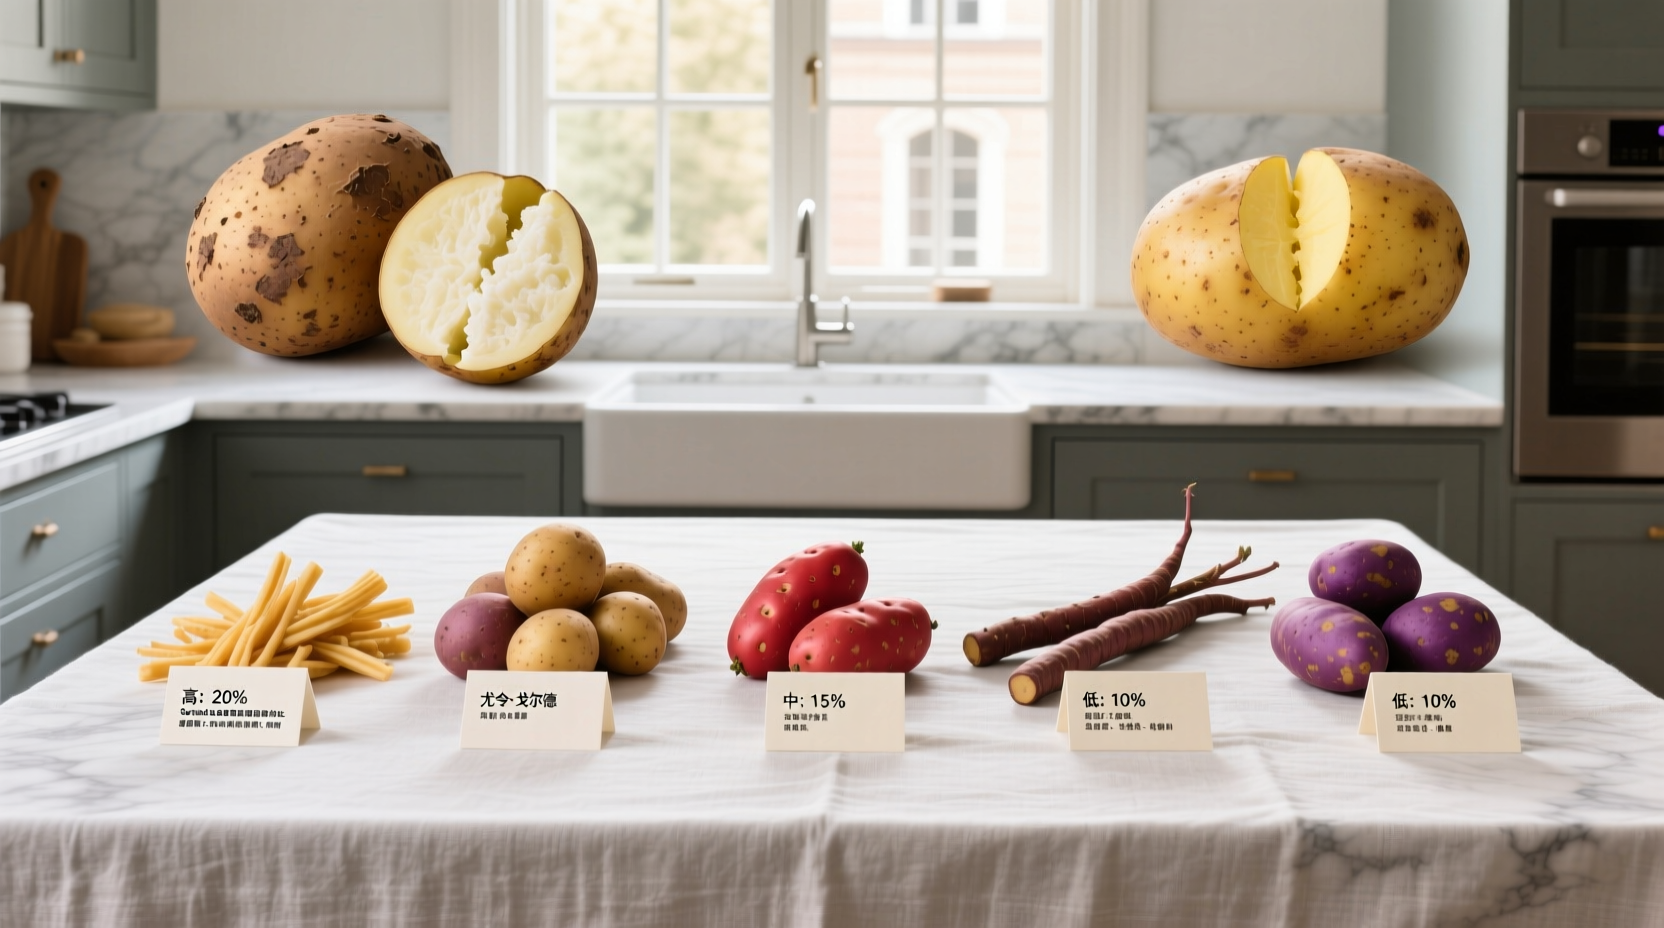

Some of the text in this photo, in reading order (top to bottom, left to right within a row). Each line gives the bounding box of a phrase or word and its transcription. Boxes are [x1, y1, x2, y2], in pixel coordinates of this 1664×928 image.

[211, 689, 248, 706] 20%
[810, 693, 846, 709] 15%
[1111, 691, 1146, 709] 10%
[1421, 693, 1457, 709] 10%
